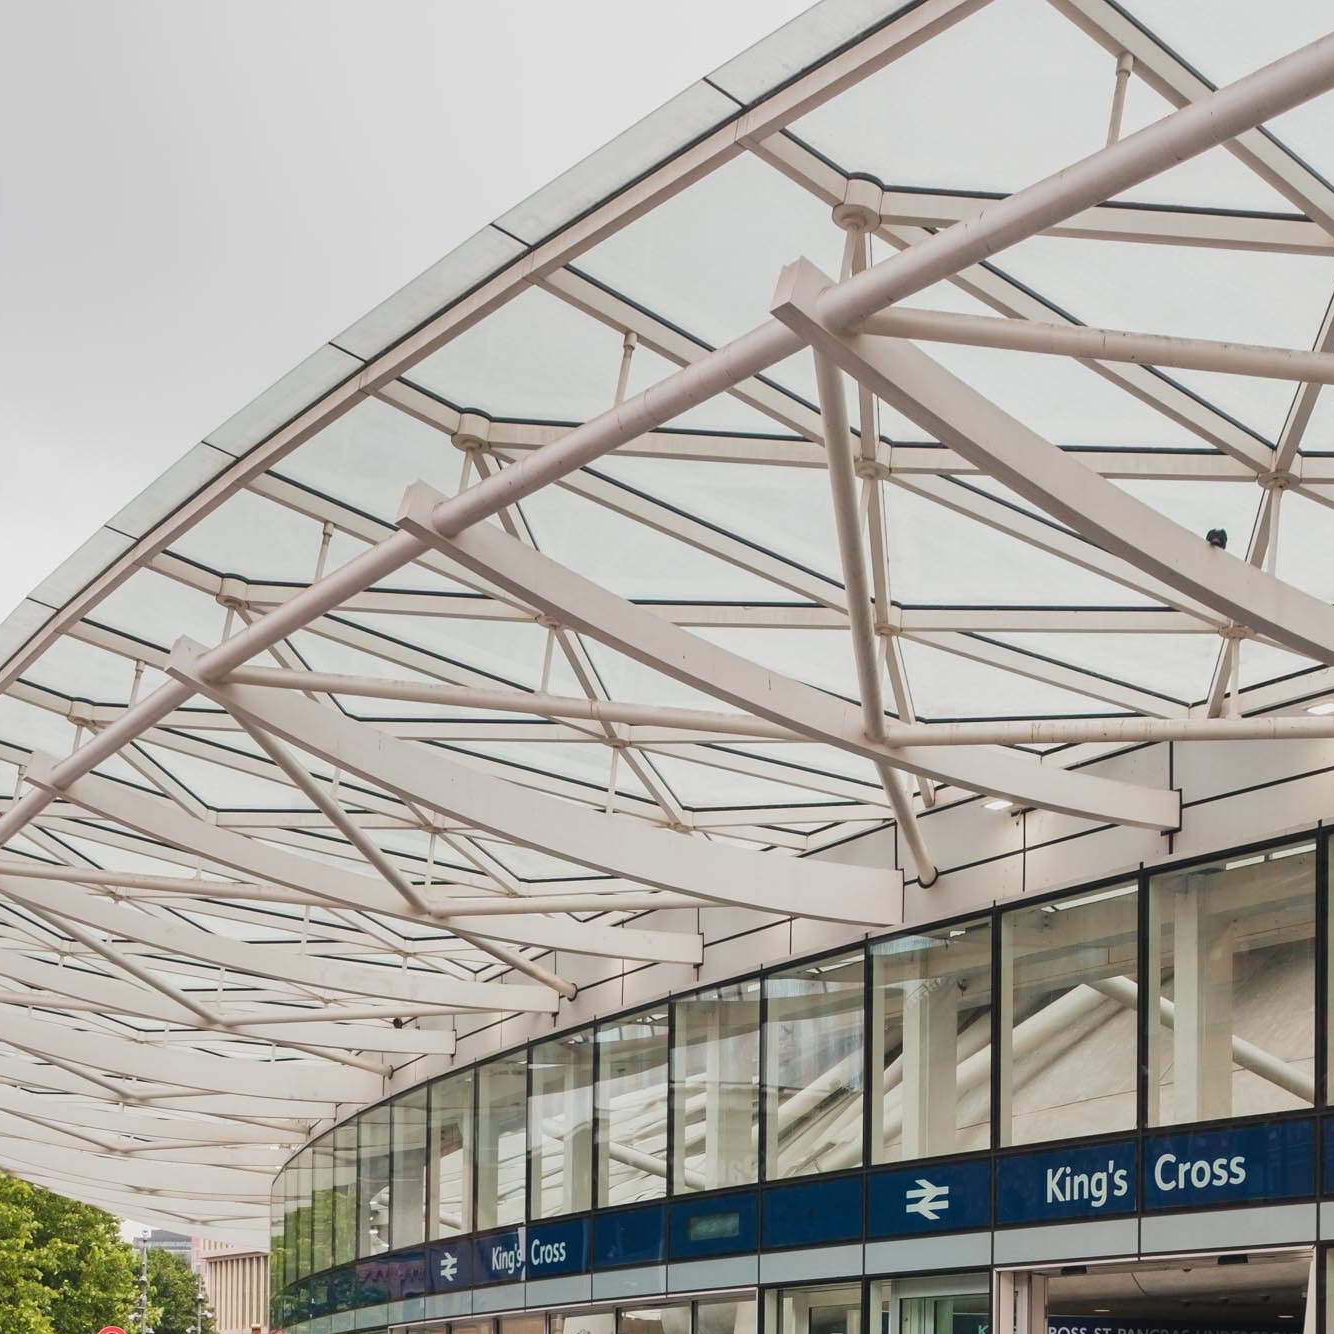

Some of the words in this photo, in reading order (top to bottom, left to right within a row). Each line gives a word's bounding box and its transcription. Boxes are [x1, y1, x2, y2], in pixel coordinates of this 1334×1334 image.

[1046, 1159, 1128, 1208] King's
[1154, 1153, 1247, 1192] Cross
[492, 1243, 522, 1275] King's
[531, 1238, 566, 1266] Cross
